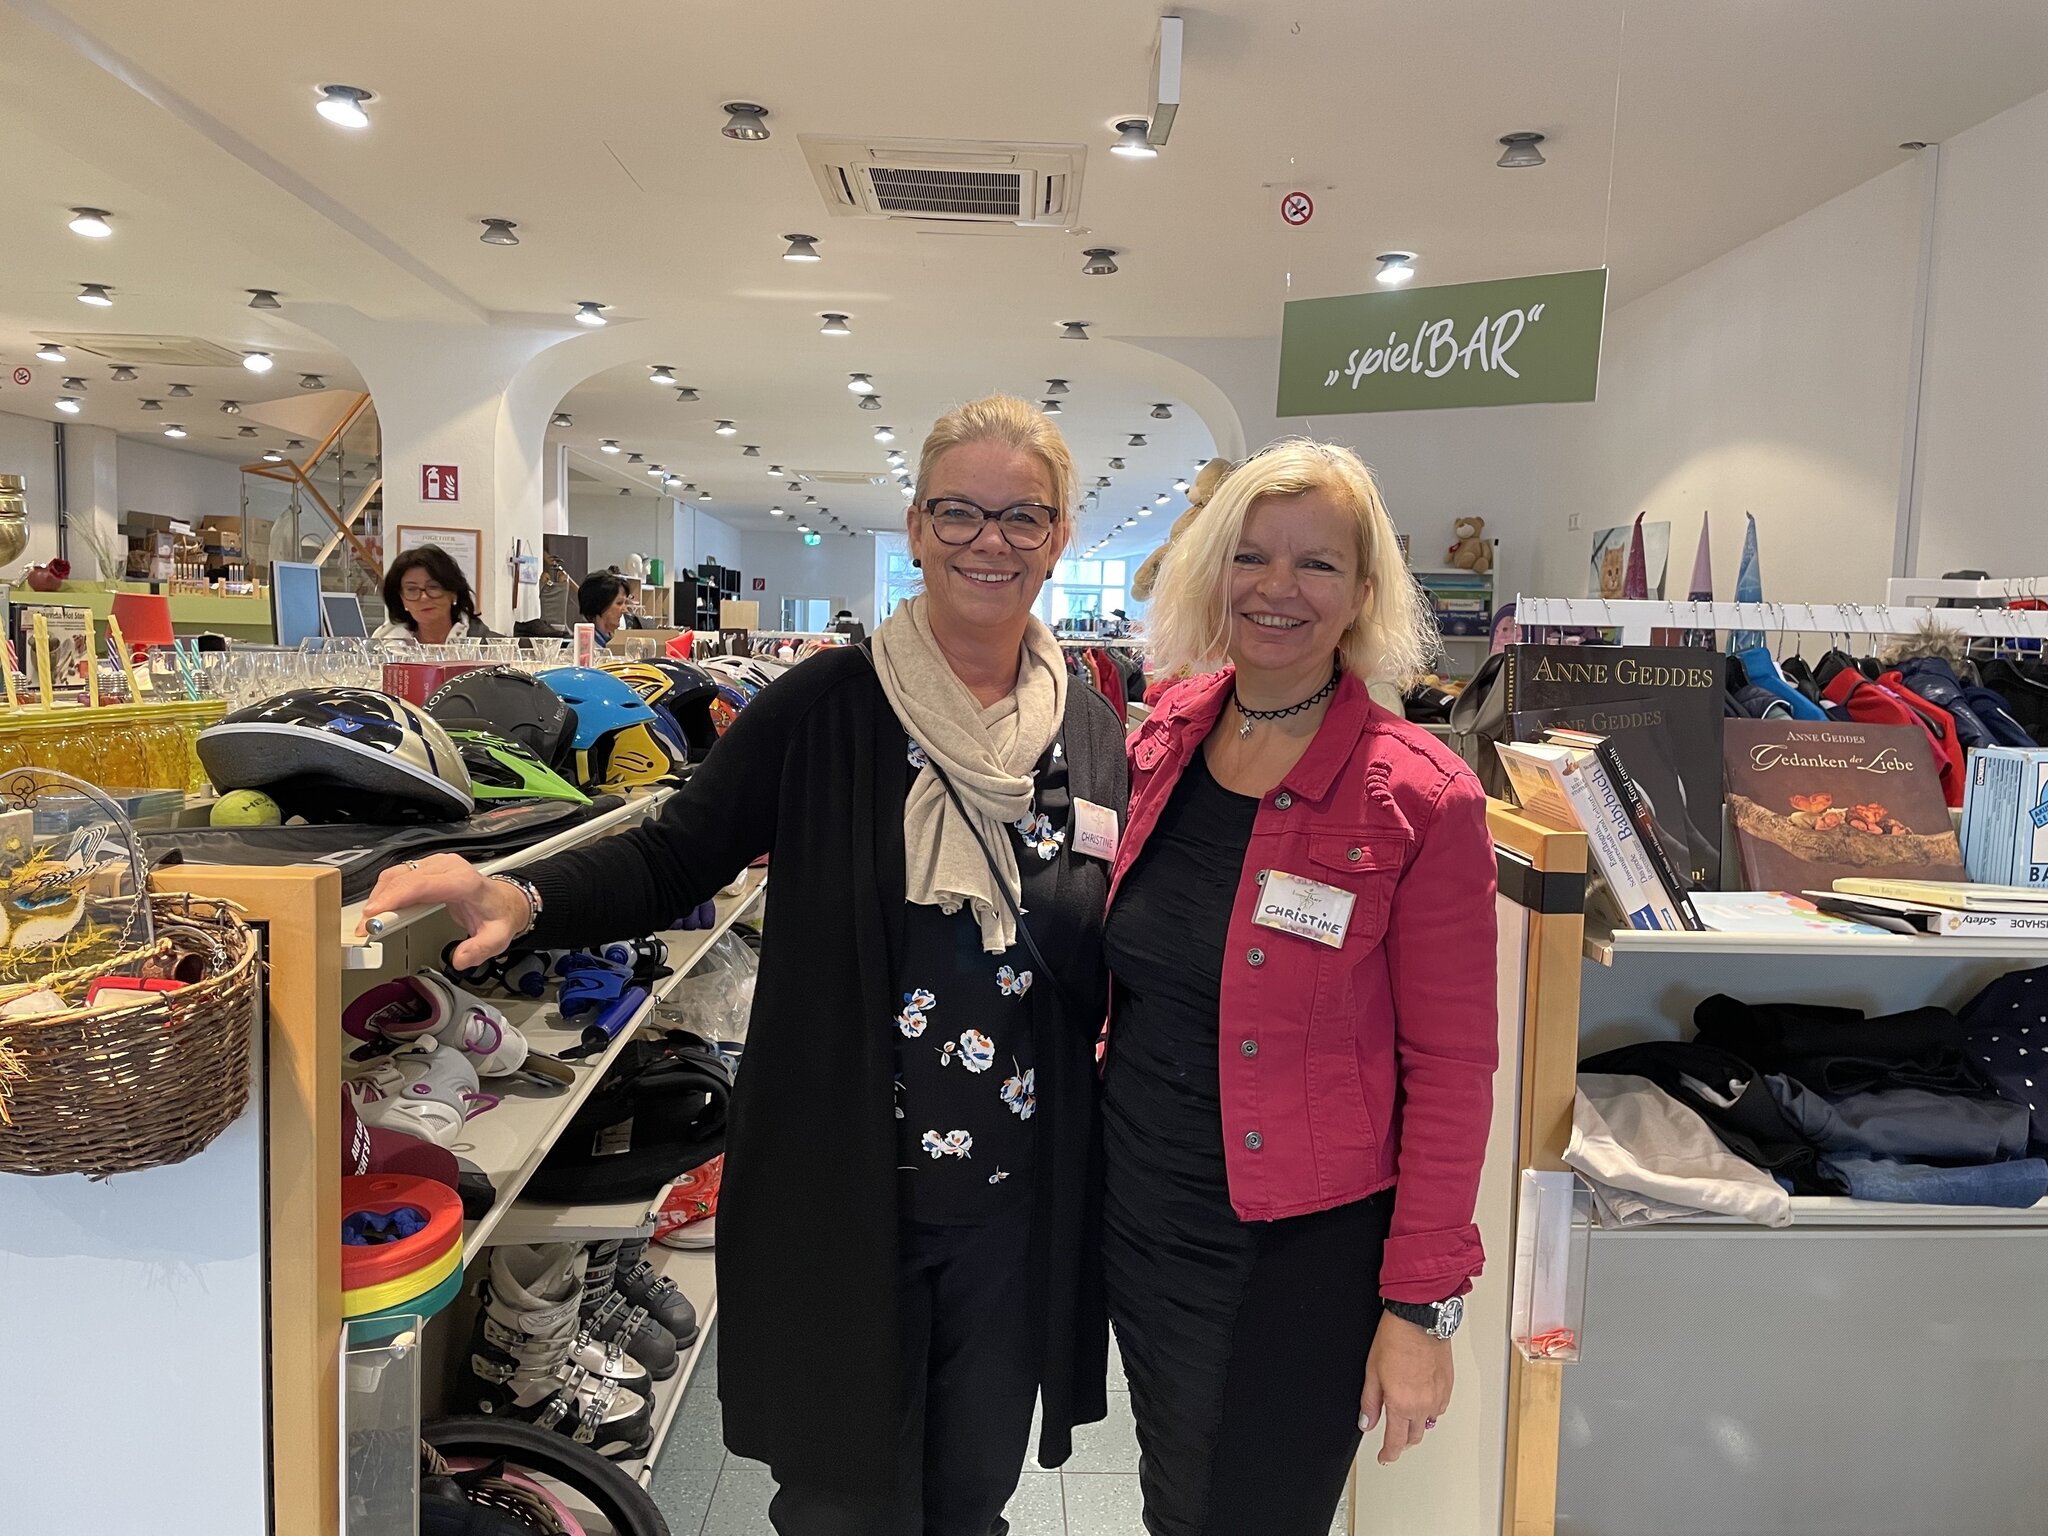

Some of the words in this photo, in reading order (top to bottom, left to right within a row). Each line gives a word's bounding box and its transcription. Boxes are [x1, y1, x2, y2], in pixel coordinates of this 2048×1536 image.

[1532, 656, 1608, 684] ANNE
[1614, 659, 1713, 688] GEDDES
[1592, 710, 1662, 732] GEDDES
[1786, 731, 1818, 743] ANNE
[1821, 732, 1865, 744] GEDDES
[1609, 747, 1629, 780] entsteht
[1750, 744, 1848, 771] Gedanken
[1849, 755, 1864, 764] der
[1857, 748, 1914, 774] Liebe
[1623, 781, 1639, 803] Kind
[1592, 769, 1633, 841] Babybuch
[1635, 802, 1646, 819] Ein
[1082, 832, 1113, 848] CHRISTINE
[1265, 905, 1342, 934] CHRISTINE
[1963, 915, 1997, 926] Safety
